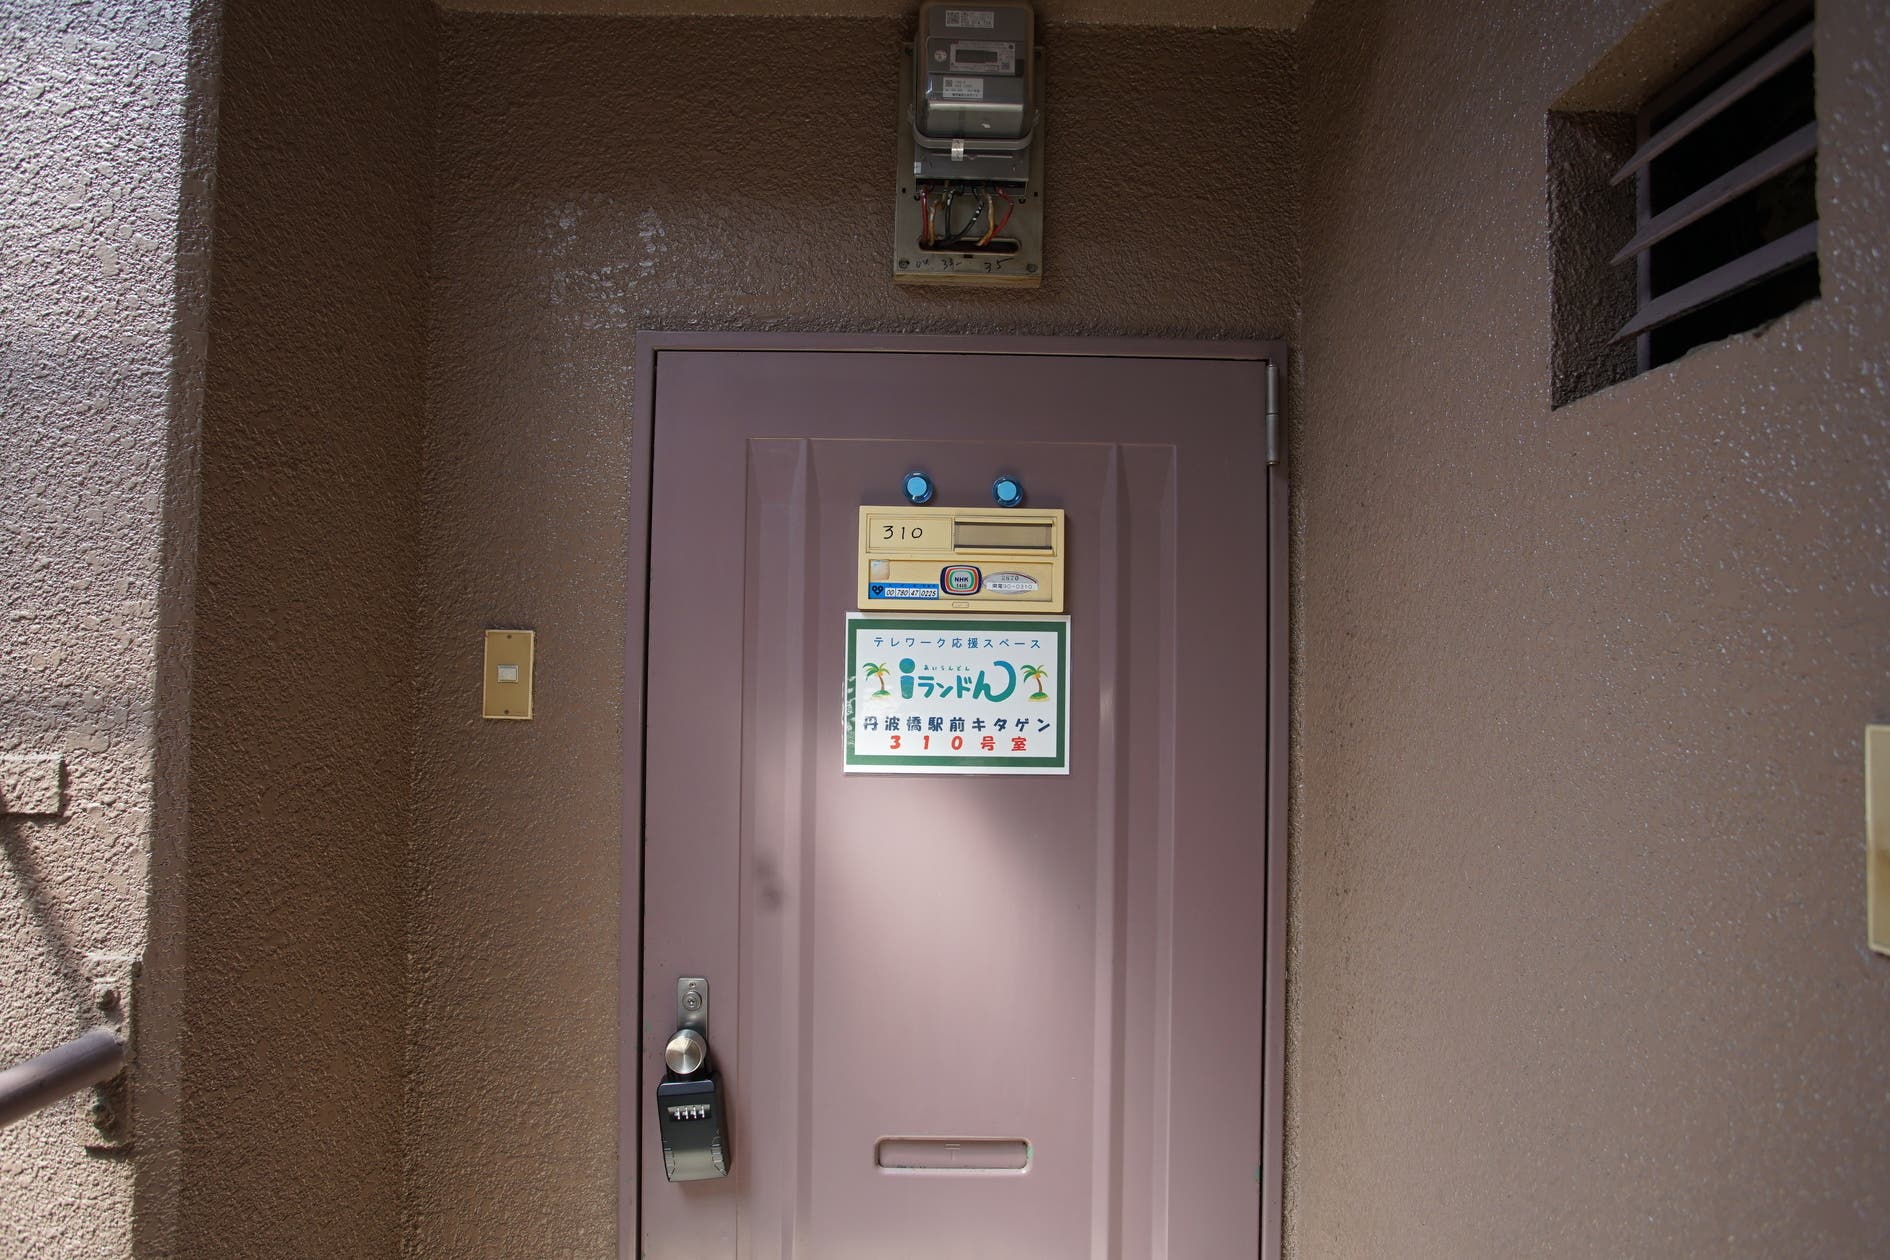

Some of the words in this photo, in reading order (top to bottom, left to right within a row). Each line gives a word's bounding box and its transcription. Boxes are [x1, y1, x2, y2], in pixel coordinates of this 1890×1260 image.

[882, 525, 923, 540] 310
[873, 636, 1041, 649] テレワーク応援スペース
[923, 664, 971, 672] あいらんどん
[863, 716, 1051, 732] 丹波橋駅前キタゲン
